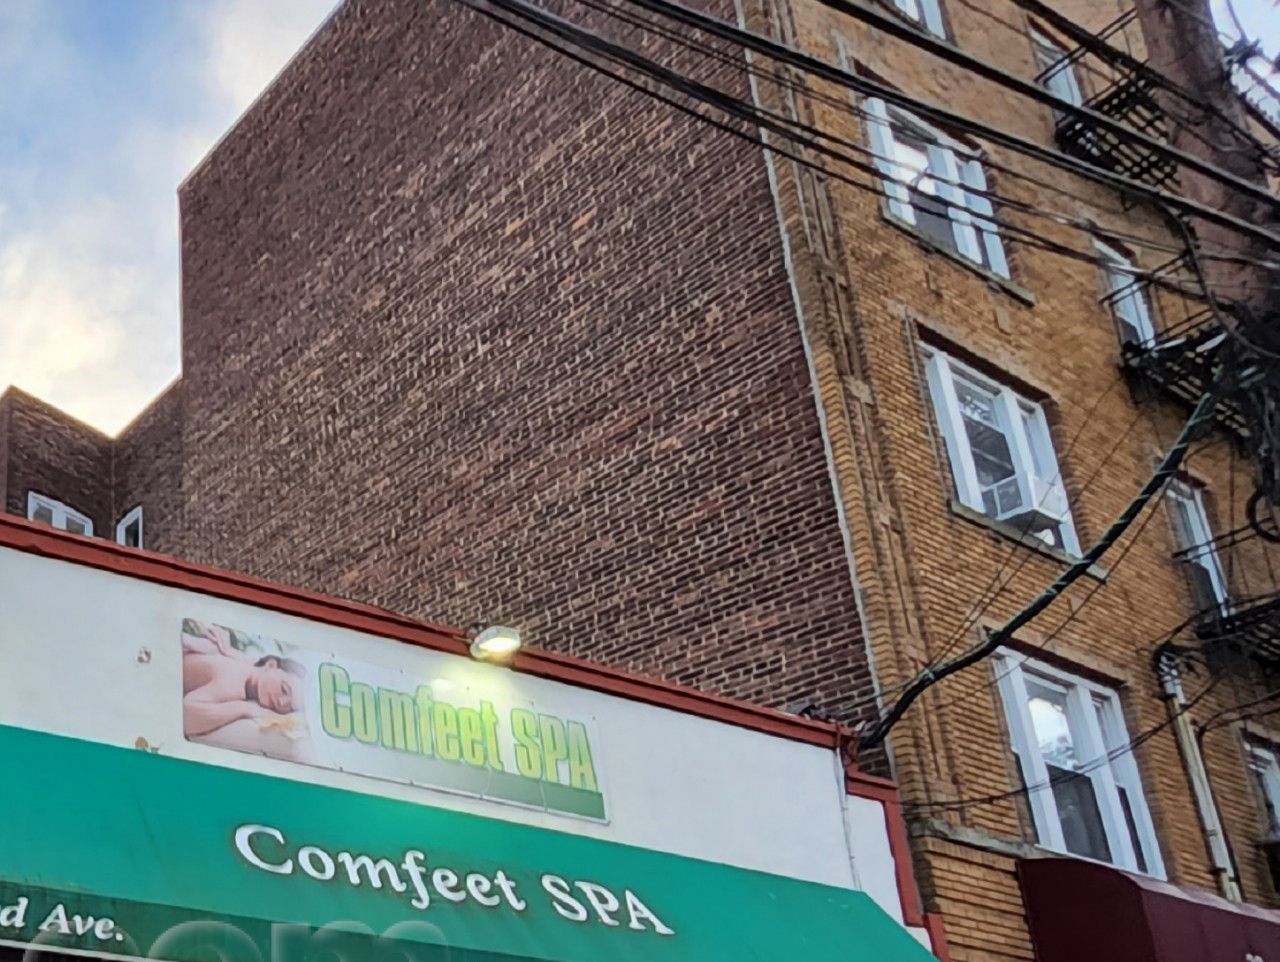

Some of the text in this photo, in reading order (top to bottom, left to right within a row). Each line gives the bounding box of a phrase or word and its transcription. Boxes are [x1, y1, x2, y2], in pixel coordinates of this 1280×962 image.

[318, 662, 599, 793] Comfeet SPA
[38, 903, 124, 942] Ave.
[234, 823, 676, 936] Comfeet SPA
